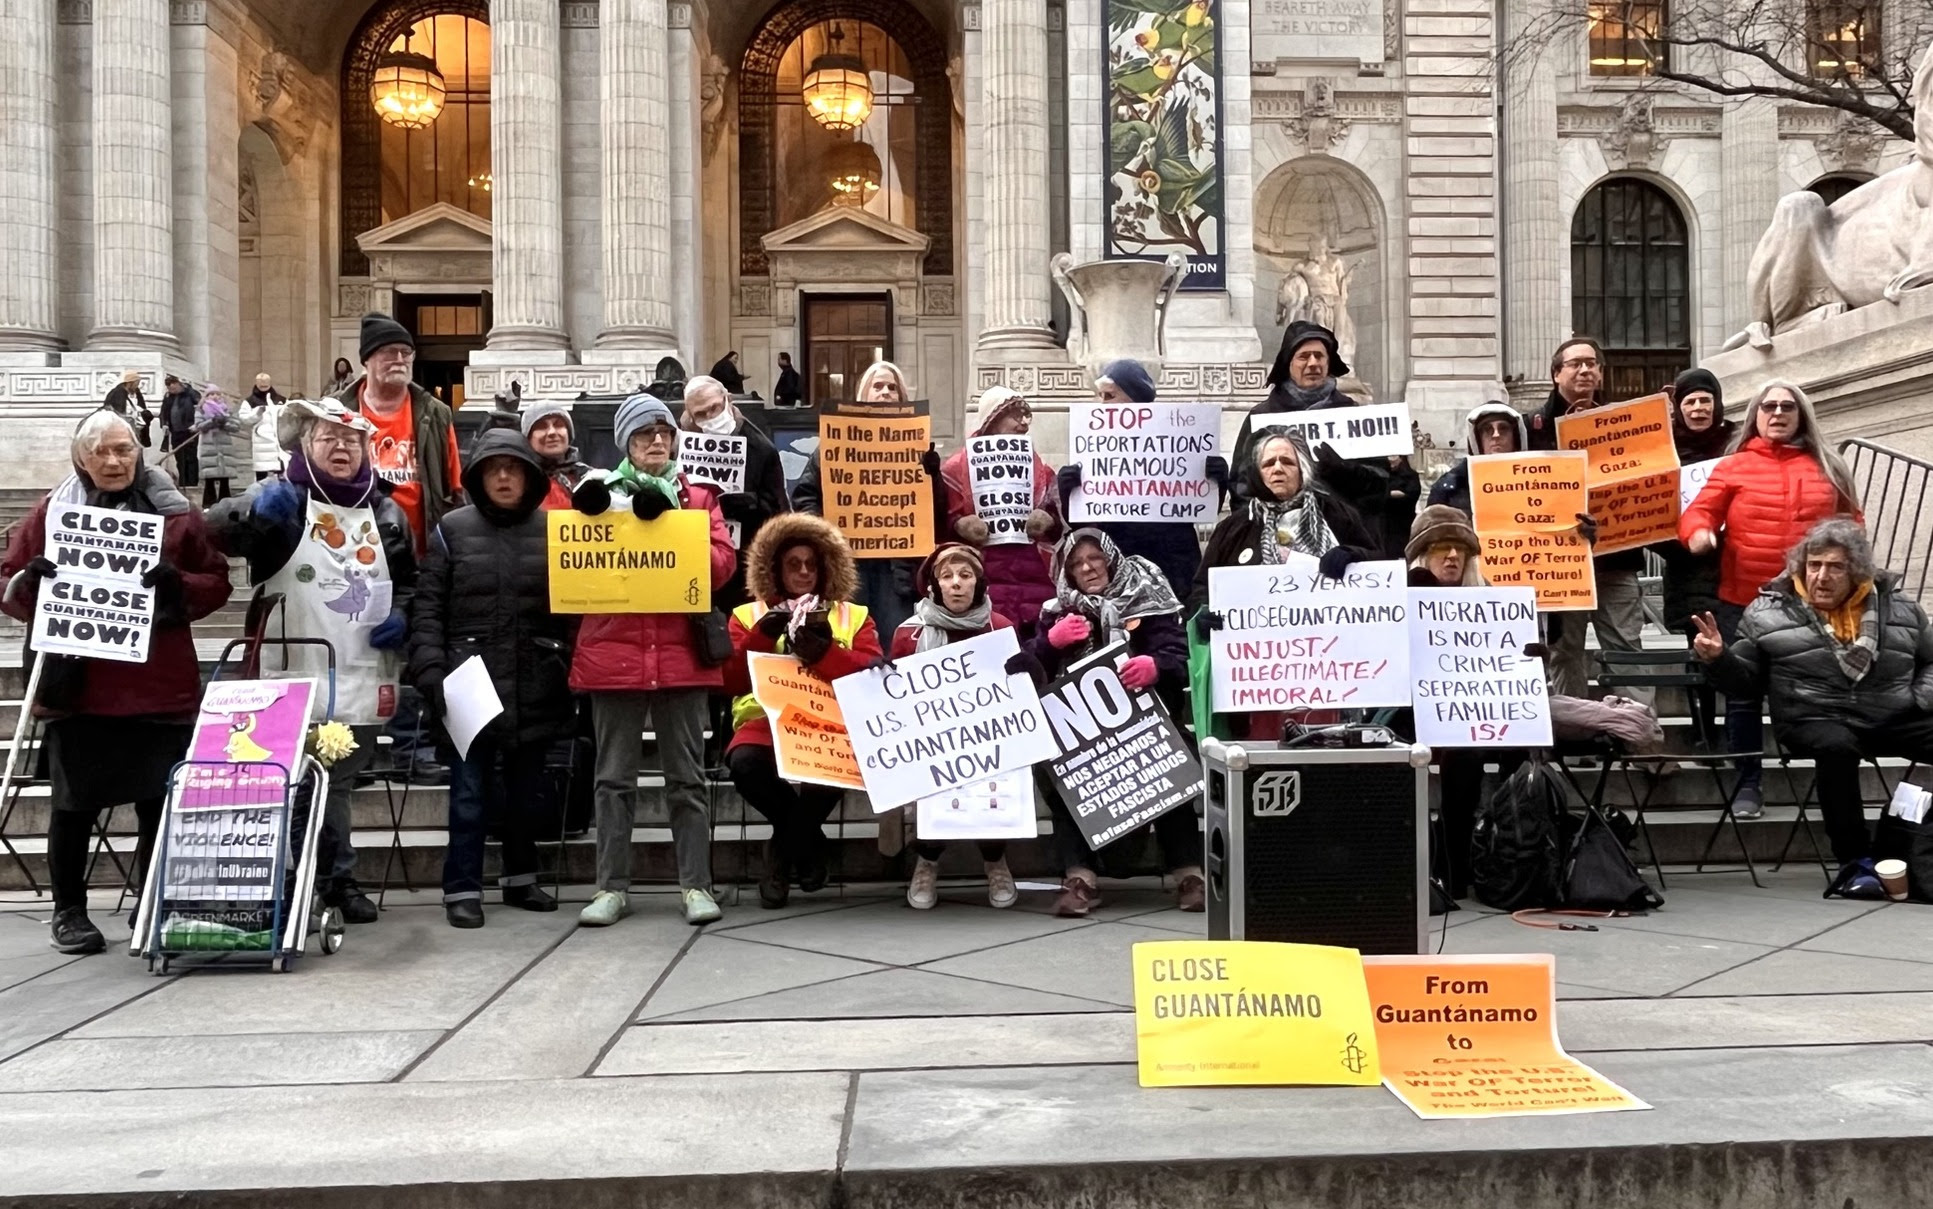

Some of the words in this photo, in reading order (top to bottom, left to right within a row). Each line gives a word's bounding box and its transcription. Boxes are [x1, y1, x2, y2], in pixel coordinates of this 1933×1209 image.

[1264, 1, 1326, 14] BEARETH
[1332, 1, 1371, 14] AWAY
[1271, 20, 1298, 33] THE
[1304, 20, 1364, 34] VICTORY
[1089, 408, 1153, 430] STOP
[1169, 410, 1196, 427] the
[1346, 416, 1399, 438] NO!!!
[1594, 413, 1632, 428] From
[827, 423, 841, 440] In
[847, 425, 873, 442] the
[879, 427, 925, 442] Name
[684, 437, 742, 454] CLOSE
[972, 439, 1029, 453] CLOSE
[1075, 433, 1214, 454] DEPORTATIONS
[1610, 447, 1624, 456] to
[825, 447, 840, 462] of
[845, 448, 925, 465] Humanity
[976, 465, 1029, 481] NOW!
[1092, 456, 1187, 477] INFAMOUS
[1512, 464, 1552, 475] From
[1600, 459, 1642, 474] Gaza:
[830, 468, 853, 484] We
[859, 469, 924, 485] REFUSE
[1482, 478, 1580, 493] Guantánamo
[1082, 478, 1211, 497] GUANTANAMO
[1617, 483, 1639, 494] the
[837, 491, 852, 506] to
[857, 490, 916, 510] Accept
[979, 492, 1031, 507] CLOSE
[1527, 496, 1542, 507] to
[1086, 501, 1150, 516] TORTURE
[1160, 502, 1206, 518] CAMP
[1514, 512, 1555, 523] Gaza:
[61, 511, 157, 539] CLOSE
[838, 515, 847, 528] a
[854, 512, 915, 529] Fascist
[53, 532, 159, 553] GUANTANAMO
[560, 524, 614, 542] CLOSE
[850, 534, 914, 550] merica!
[1488, 538, 1523, 550] Stop
[1529, 536, 1550, 547] the
[1555, 535, 1580, 547] U.S.
[57, 547, 150, 580] NOW!
[560, 547, 676, 569] GUANTÁNAMO
[1485, 555, 1515, 565] War
[1521, 553, 1540, 564] OF
[1544, 552, 1587, 563] Terror
[1268, 575, 1299, 594] 23
[1308, 571, 1392, 592] YEARS!
[1493, 571, 1520, 582] and
[1526, 569, 1583, 580] Torture!
[52, 582, 149, 611] CLOSE
[43, 603, 150, 625] GUANTANAMO
[1221, 605, 1406, 631] CLOSEGUANTANAMO
[1418, 600, 1534, 623] MIGRATION
[47, 617, 140, 647] NOW!
[1429, 629, 1447, 646] IS
[1453, 631, 1491, 648] NOT
[1500, 631, 1516, 649] A
[1227, 635, 1338, 660] UNJUST!
[882, 650, 977, 700] CLOSE
[1231, 659, 1387, 682] ILLEGITIMATE!
[768, 675, 837, 700] Guantán
[1232, 687, 1358, 706] IMMORAL!
[1418, 678, 1542, 698] SEPARATING
[810, 700, 824, 712] to
[866, 711, 907, 738] U.S.
[913, 681, 1014, 727] PRISON
[1435, 701, 1538, 722] FAMILIES
[784, 725, 812, 739] War
[1470, 723, 1509, 742] IS!
[795, 743, 822, 754] and
[1062, 766, 1093, 790] NOS
[1091, 731, 1157, 774] NEGAMOS
[1157, 725, 1170, 739] A
[790, 757, 810, 767] The
[929, 744, 1001, 787] NOW
[1078, 759, 1139, 800] ACEPTAR
[1139, 753, 1152, 767] A
[1150, 740, 1173, 759] UN
[1076, 777, 1137, 818] ESTADOS
[1136, 750, 1188, 784] UNIDOS
[1107, 776, 1174, 819] FASCISTA
[232, 810, 272, 824] THE
[175, 832, 275, 846] VIOLENCE!
[1152, 958, 1230, 982] CLOSE
[1425, 976, 1489, 995] From
[1154, 987, 1322, 1019] GUANTÁNAMO
[1376, 1004, 1537, 1023] Guantánamo
[1446, 1034, 1472, 1050] to
[1403, 1068, 1463, 1077] Stop
[1405, 1079, 1457, 1087] War
[1507, 1076, 1591, 1085] Terror
